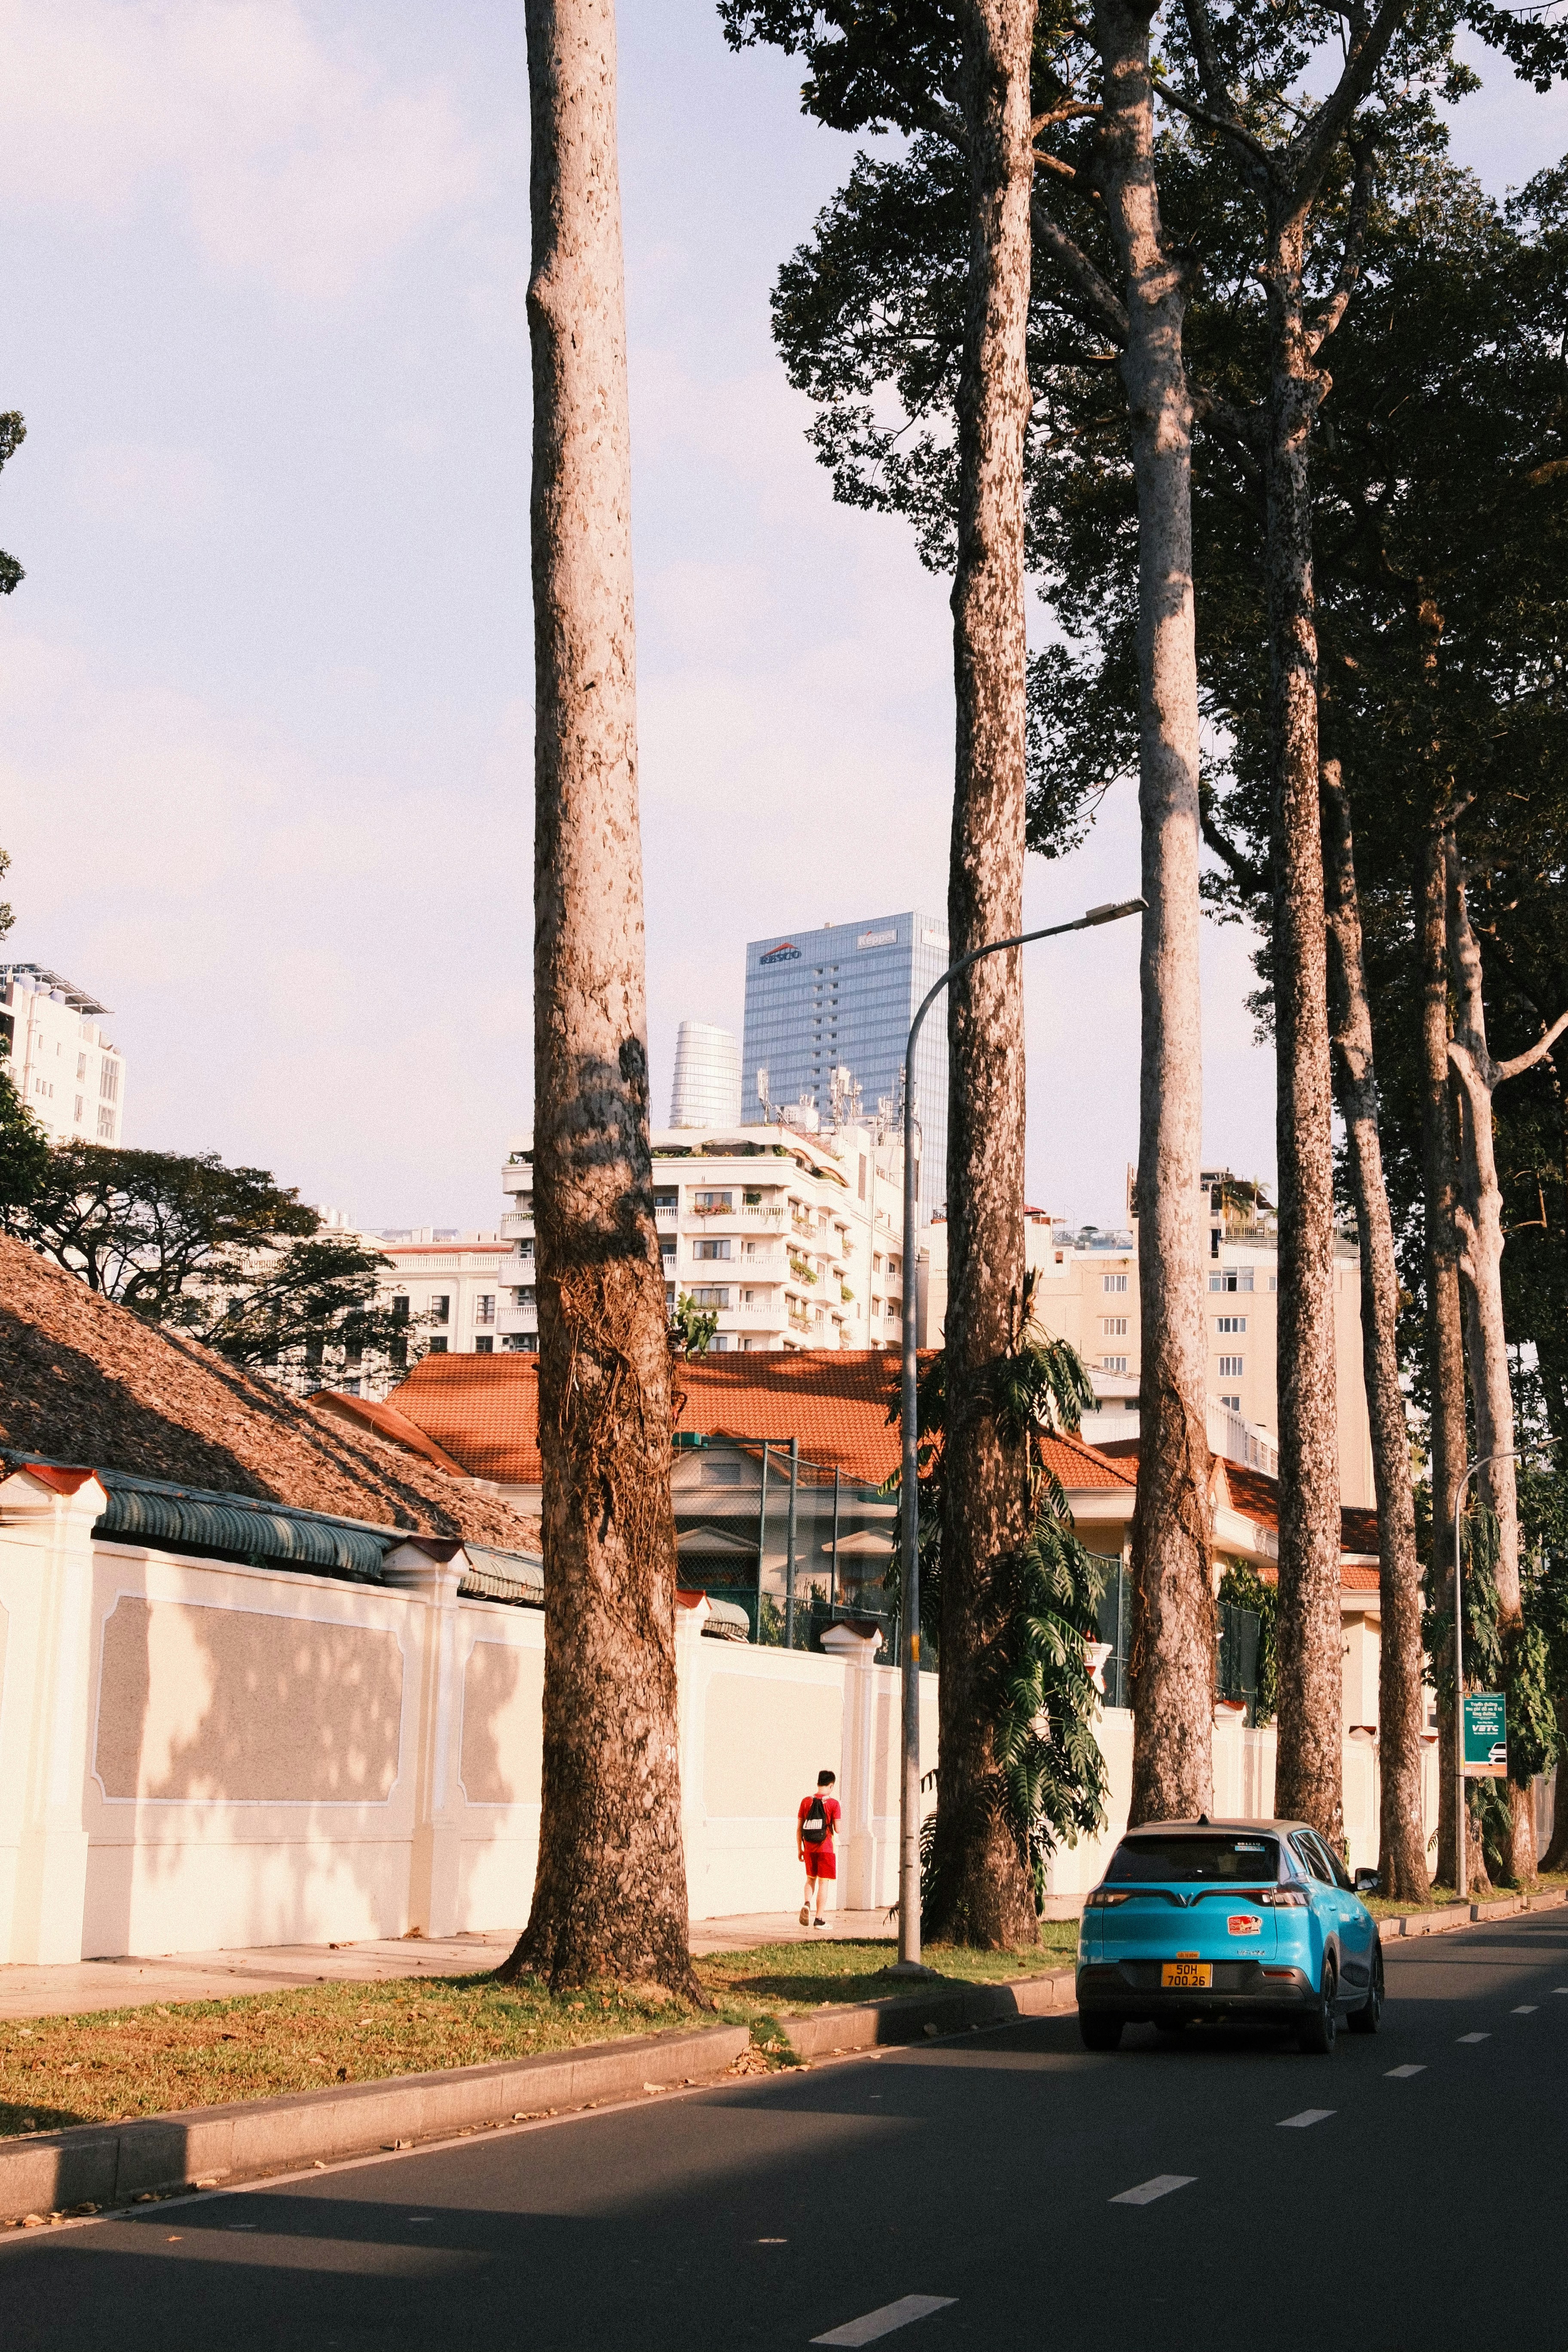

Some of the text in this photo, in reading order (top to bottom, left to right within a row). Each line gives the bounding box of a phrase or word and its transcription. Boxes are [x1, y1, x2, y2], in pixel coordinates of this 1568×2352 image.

[858, 931, 895, 947] Keppel
[665, 1744, 676, 1763] 30
[1176, 1965, 1197, 1974] 50H
[1168, 1975, 1205, 1986] 700.26
